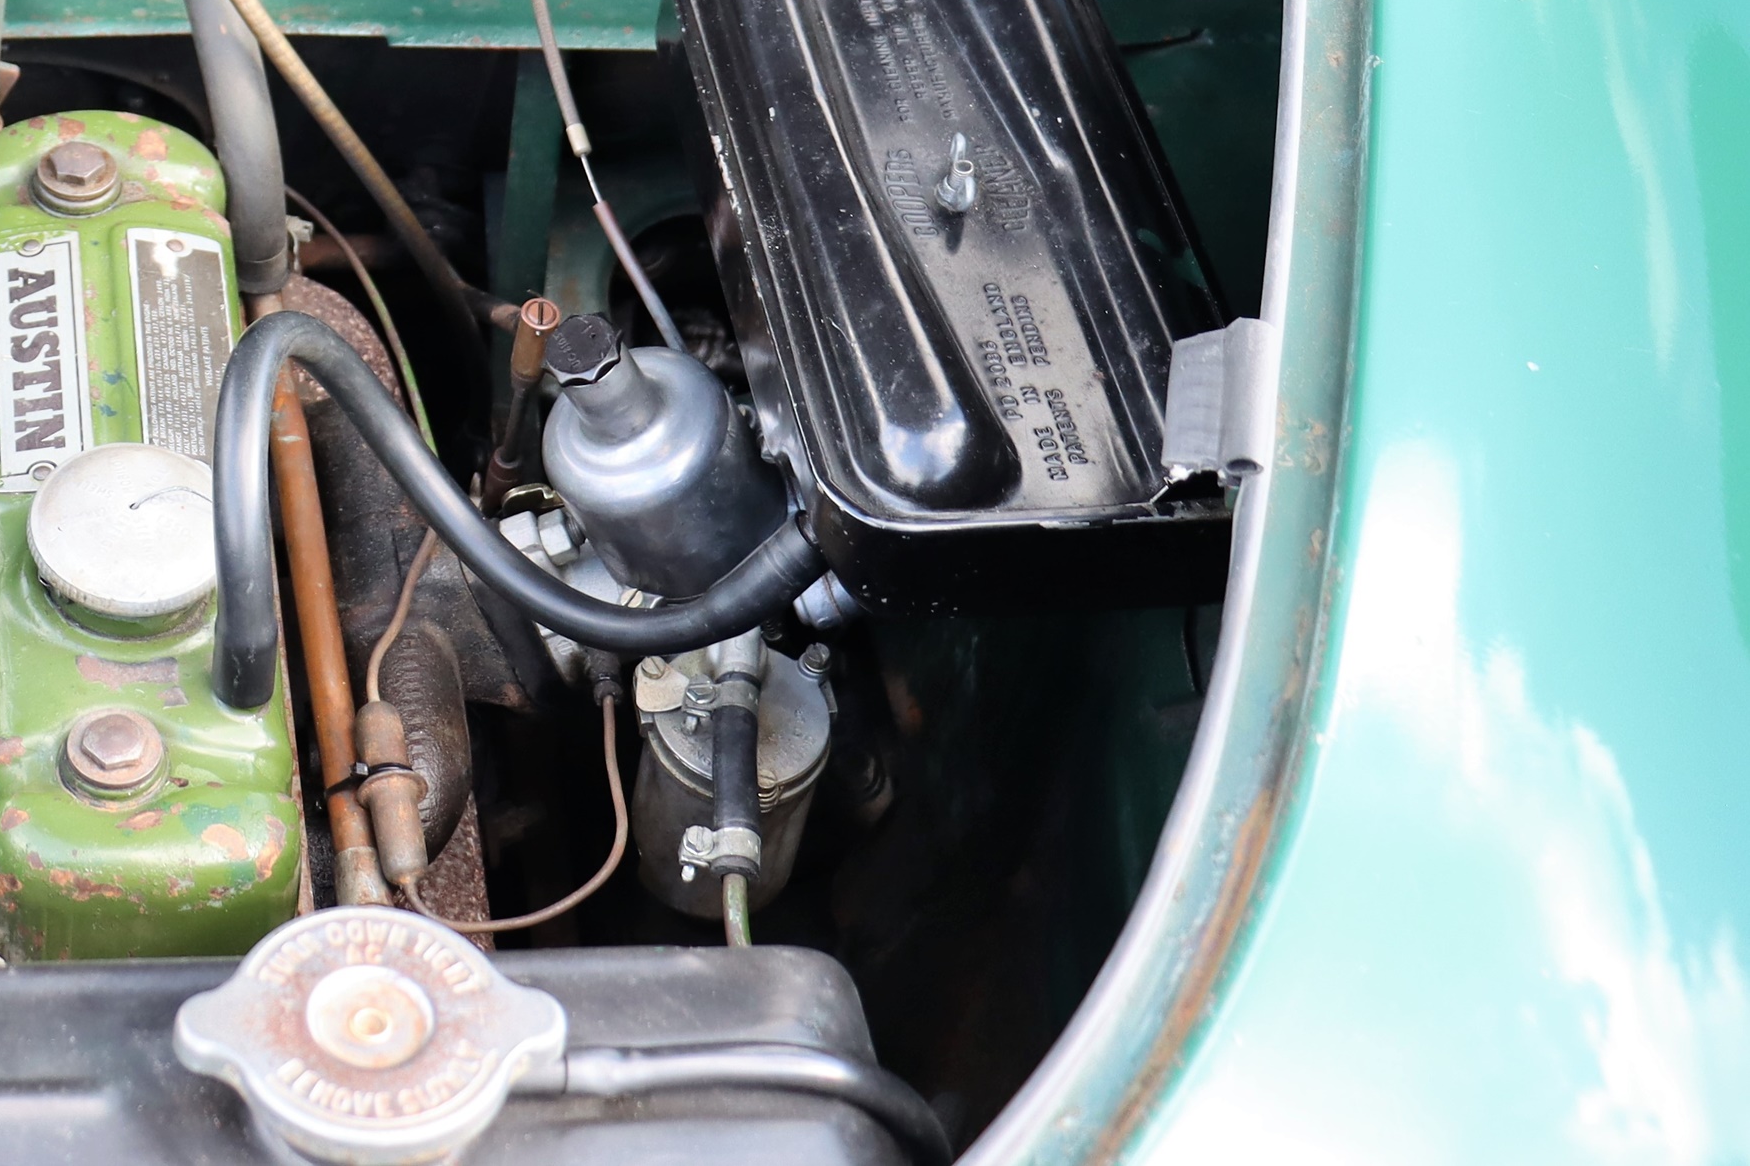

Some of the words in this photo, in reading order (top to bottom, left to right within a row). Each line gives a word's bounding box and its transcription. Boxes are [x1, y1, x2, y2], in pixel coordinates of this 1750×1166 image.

[872, 35, 903, 92] CLEANING
[885, 148, 940, 239] COOPERS
[200, 325, 210, 353] PATENTS
[983, 282, 1027, 367] ENGLAND
[1011, 295, 1050, 368] PENDING
[7, 267, 67, 453] AUSTIN
[203, 355, 212, 386] WESLAKE
[998, 395, 1024, 421] PD
[1020, 385, 1042, 405] IN
[1034, 426, 1069, 482] MADE
[1045, 388, 1089, 465] PATENTS
[324, 918, 407, 946] DOWN
[412, 932, 476, 994] TIGHT
[276, 1057, 393, 1118] REMOVE
